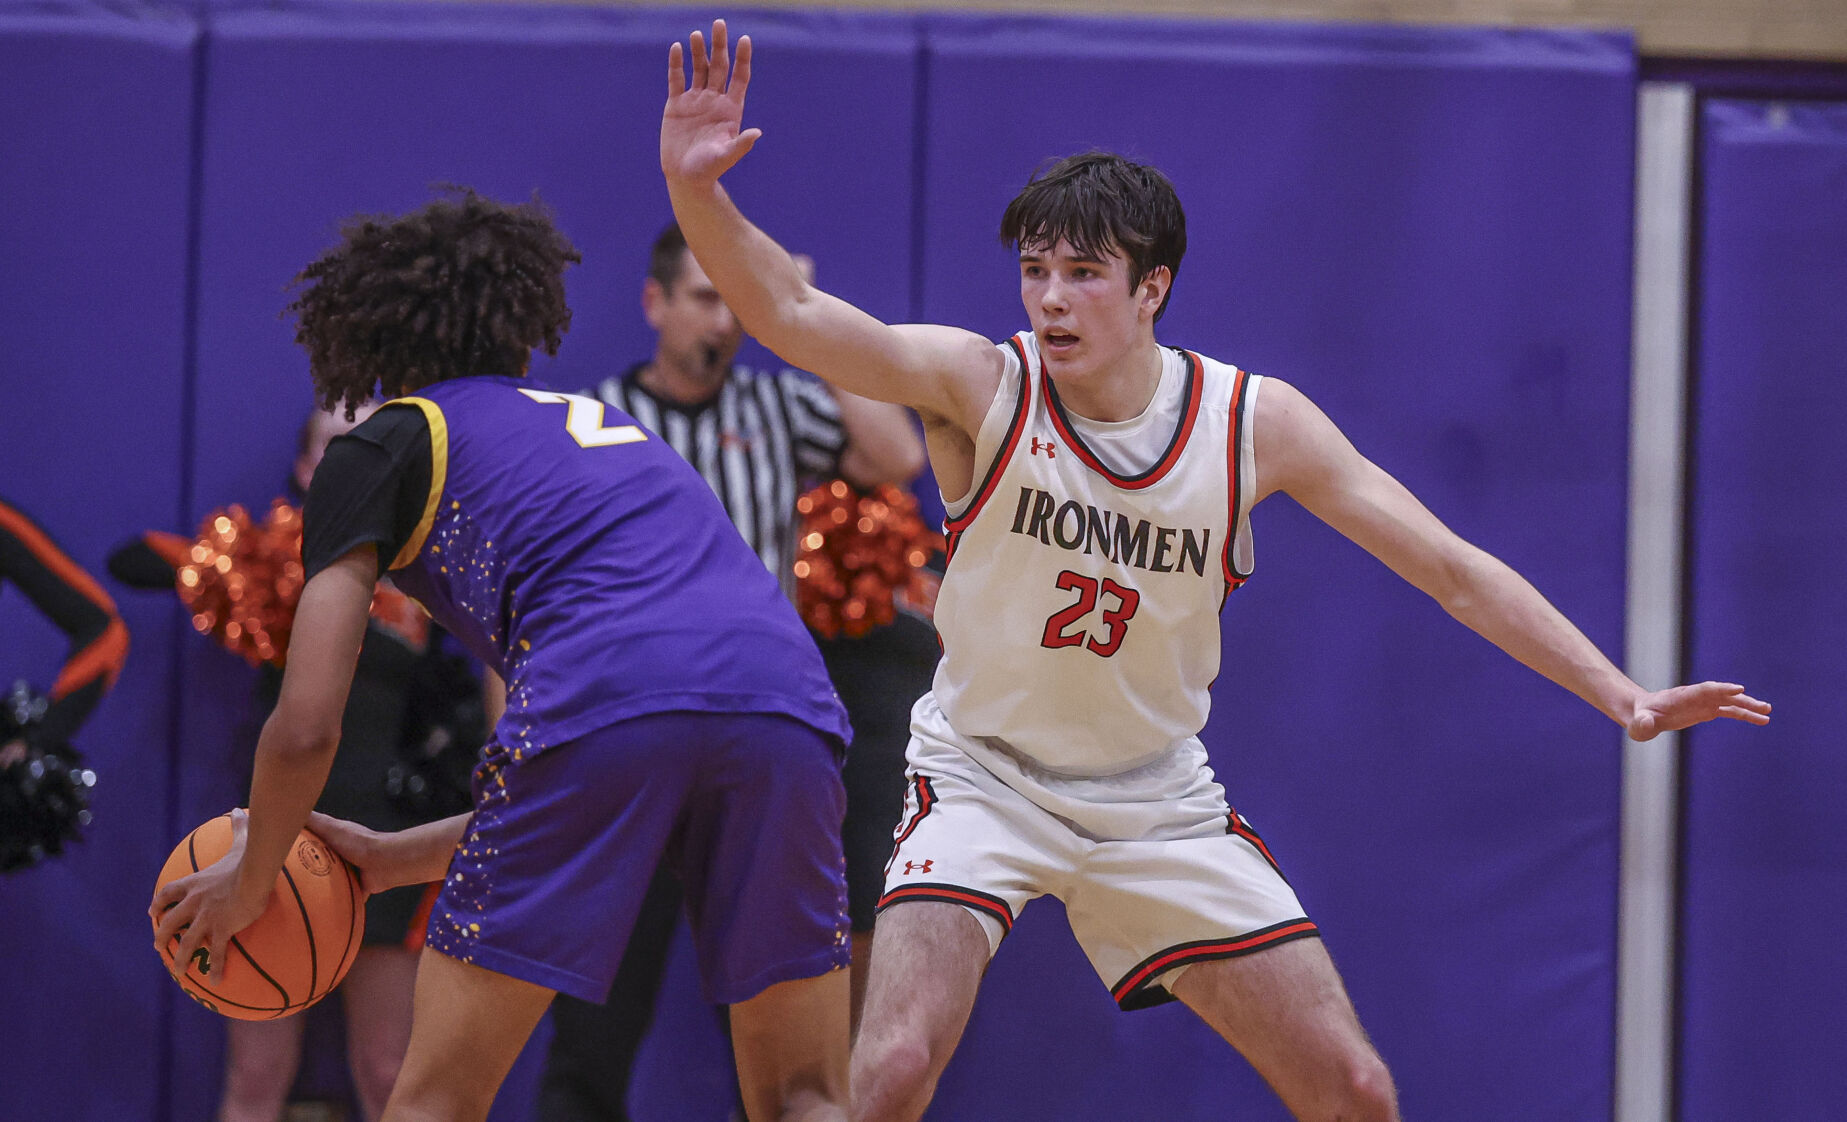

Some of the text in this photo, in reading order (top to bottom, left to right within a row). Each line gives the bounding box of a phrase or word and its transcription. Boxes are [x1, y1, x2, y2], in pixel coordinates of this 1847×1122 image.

[517, 388, 648, 448] 2
[1010, 486, 1210, 577] IRONMEN
[1040, 570, 1140, 657] 23
